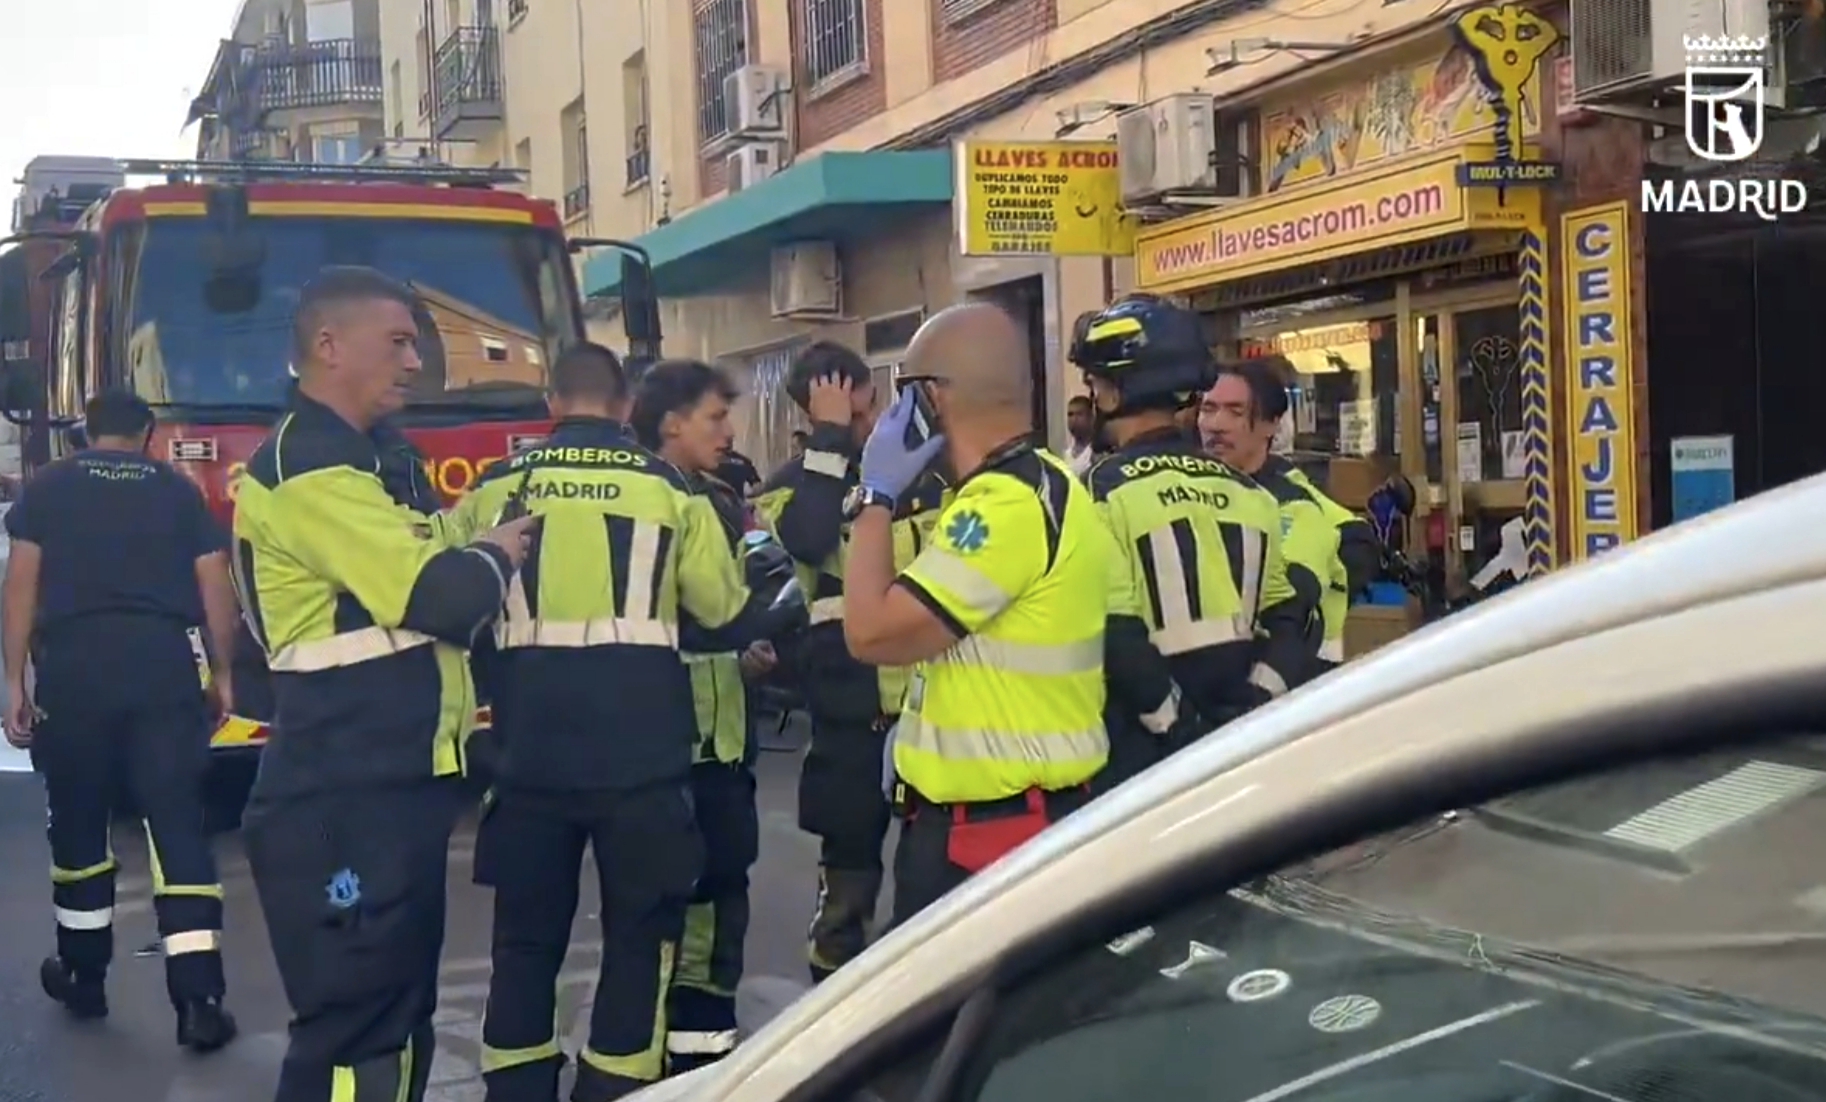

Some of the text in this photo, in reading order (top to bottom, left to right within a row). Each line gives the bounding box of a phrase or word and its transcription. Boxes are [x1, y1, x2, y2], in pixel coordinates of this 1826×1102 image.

[975, 149, 1118, 168] LLAVES ACRO
[975, 173, 1069, 184] DUPLICAMOS TODO
[1470, 165, 1555, 180] MUL-T-LOCK
[983, 184, 1061, 195] TIPO DE LLAVES
[988, 198, 1053, 208] CAMBIAMOS
[986, 211, 1055, 221] CERRADURAS
[1153, 181, 1444, 275] www.llavesacrom.com
[510, 447, 648, 468] BOMBEROS
[521, 481, 621, 500] MADRID
